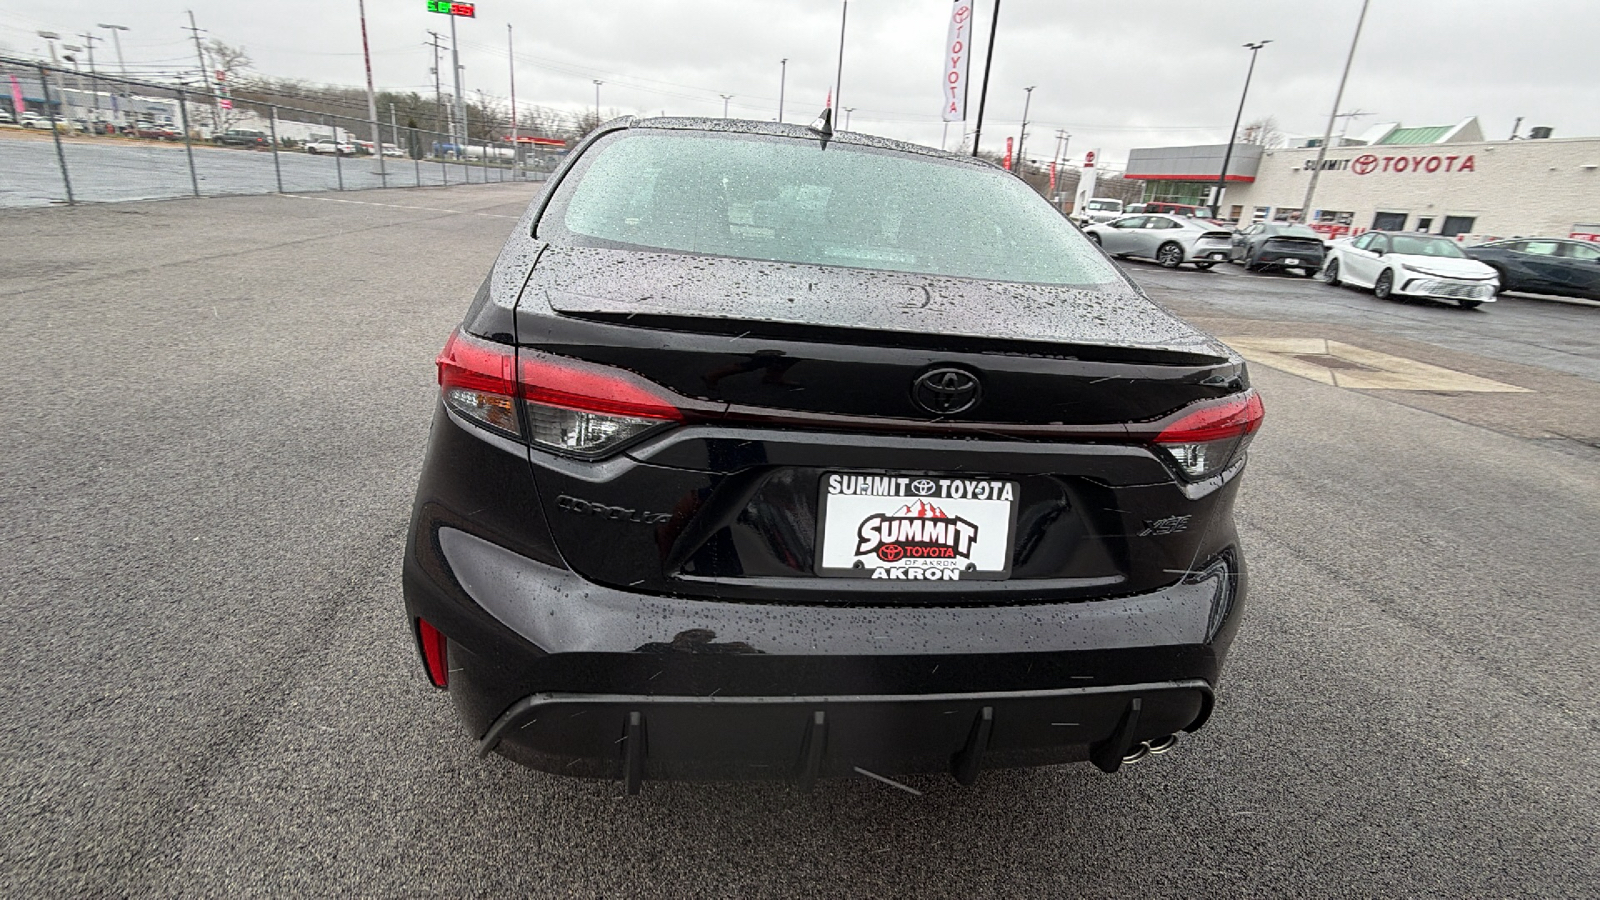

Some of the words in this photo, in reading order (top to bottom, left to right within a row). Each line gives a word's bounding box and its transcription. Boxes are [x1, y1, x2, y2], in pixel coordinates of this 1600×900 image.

[947, 25, 964, 114] TOYOTA
[1303, 159, 1351, 171] SUMMIT
[1382, 155, 1476, 174] TOYOTA
[828, 474, 910, 497] SUMMIT
[939, 479, 1014, 502] TOYOTA
[859, 516, 976, 555] SUMMIT
[905, 546, 955, 558] TOYOTA
[921, 559, 957, 567] AKRON
[871, 566, 961, 581] AKRON
